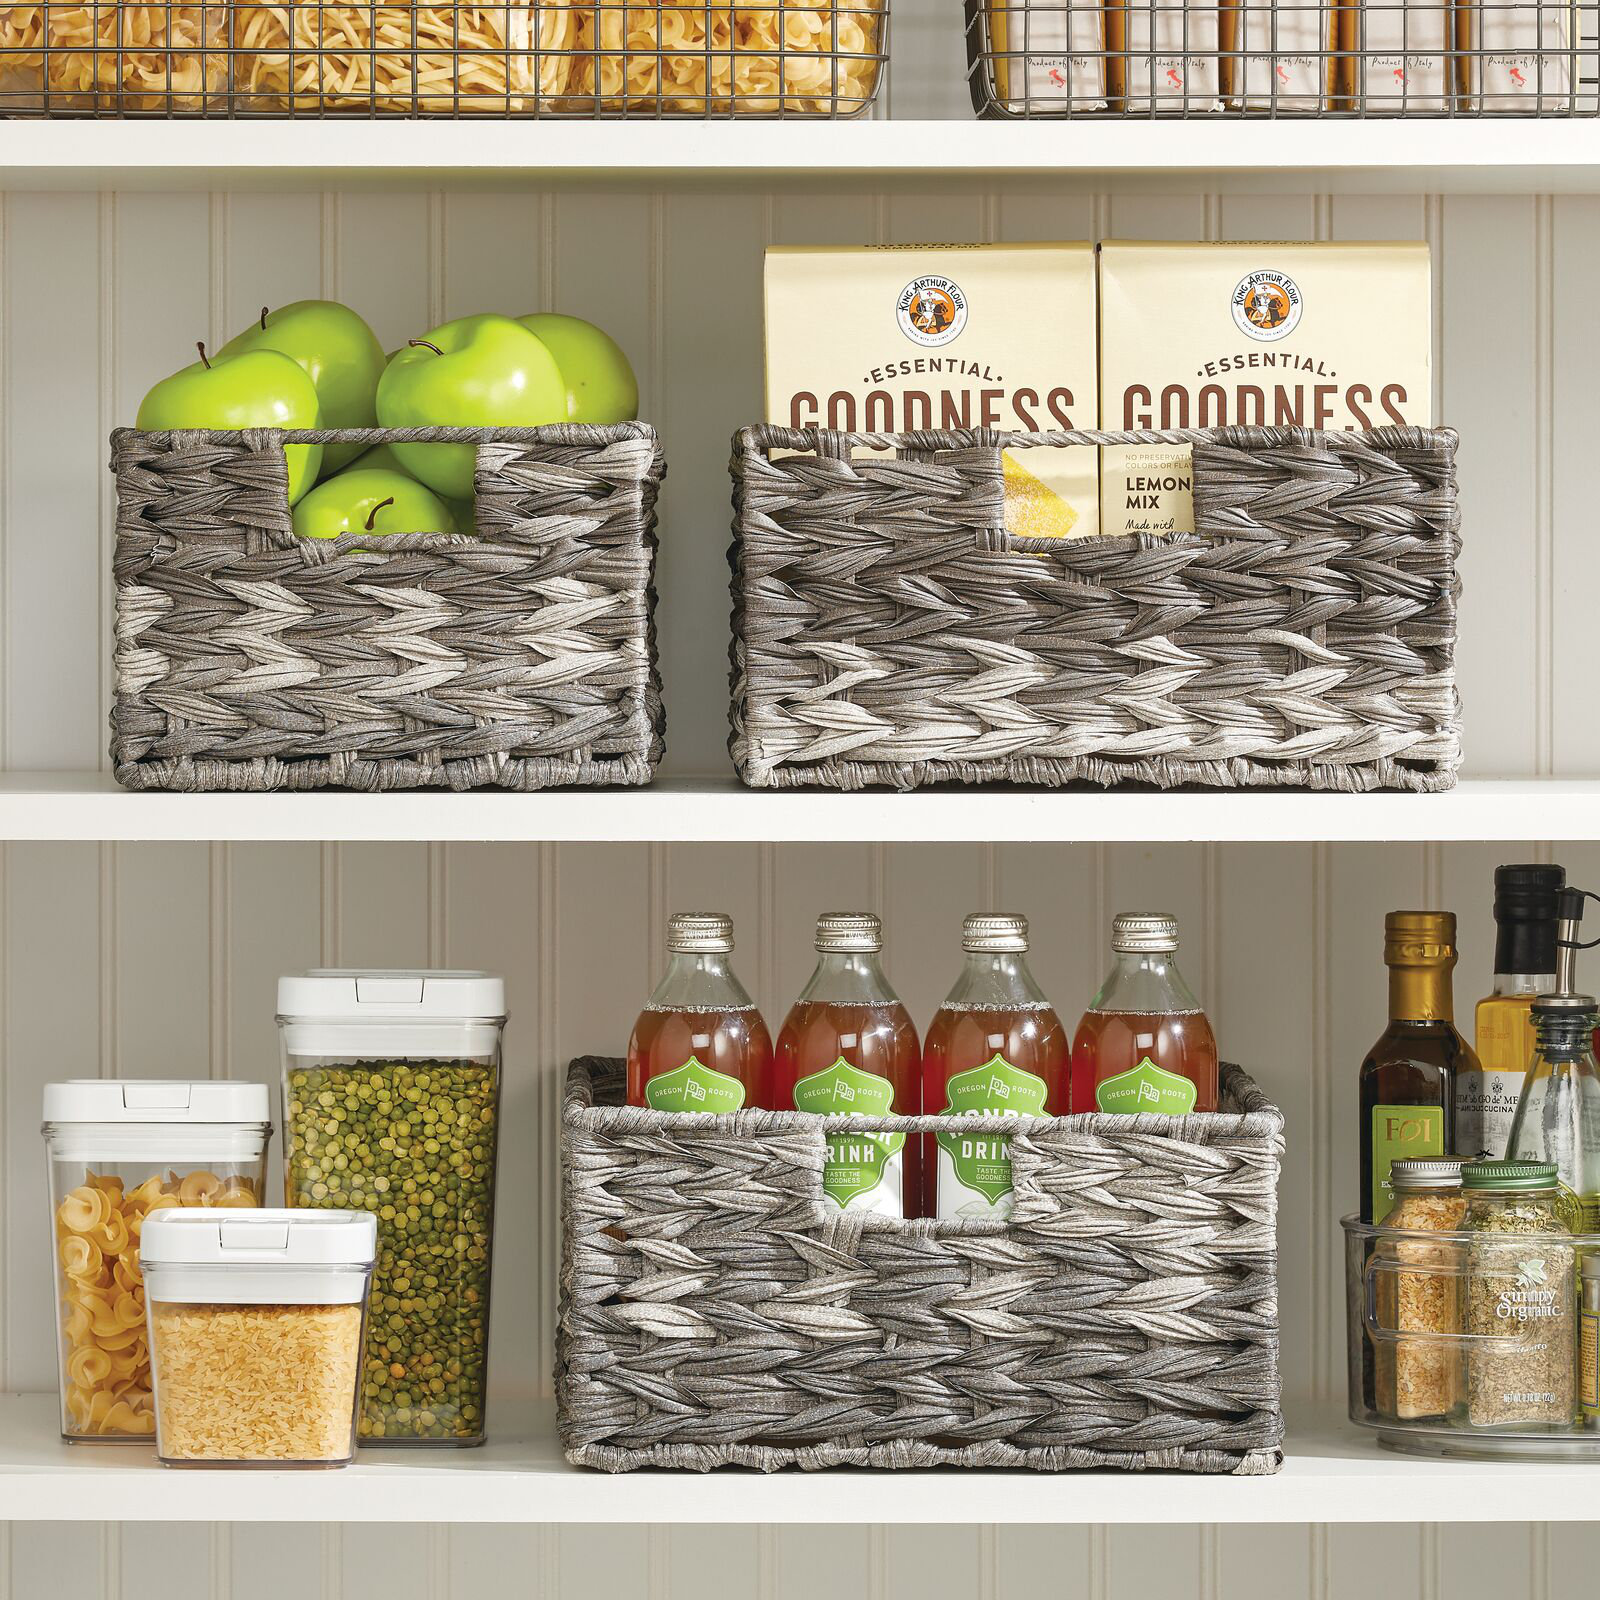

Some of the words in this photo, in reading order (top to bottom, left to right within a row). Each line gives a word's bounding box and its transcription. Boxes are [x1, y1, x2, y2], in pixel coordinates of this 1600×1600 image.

[1144, 57, 1173, 68] Pduct
[1371, 56, 1401, 67] Product
[1487, 55, 1517, 67] Product
[1530, 55, 1549, 68] Itly
[898, 290, 914, 312] KING
[912, 278, 948, 294] ARTHUR
[946, 285, 965, 311] FLOUR
[1233, 284, 1249, 307] KING
[1247, 273, 1283, 289] ARTHUR
[1281, 279, 1299, 306] FLOUR
[870, 358, 993, 384] ESSENTIAL
[1203, 352, 1327, 378] ESSENTIAL
[790, 387, 1075, 434] GOODNESS
[1123, 383, 1408, 432] GOODNESS
[1126, 477, 1191, 491] LEMON
[1126, 495, 1160, 509] MIX
[1125, 518, 1151, 530] Made
[1153, 517, 1175, 530] with
[654, 1086, 683, 1097] OREGON
[708, 1087, 734, 1099] ROOTS
[803, 1087, 832, 1099] OREGON
[857, 1087, 883, 1099] ROOTS
[956, 1083, 986, 1095] OREGON
[1012, 1085, 1037, 1097] ROOTS
[1106, 1088, 1136, 1100] OREGON
[1161, 1088, 1187, 1100] ROOTS
[826, 1144, 875, 1163] RINK
[961, 1140, 1011, 1161] DRIN
